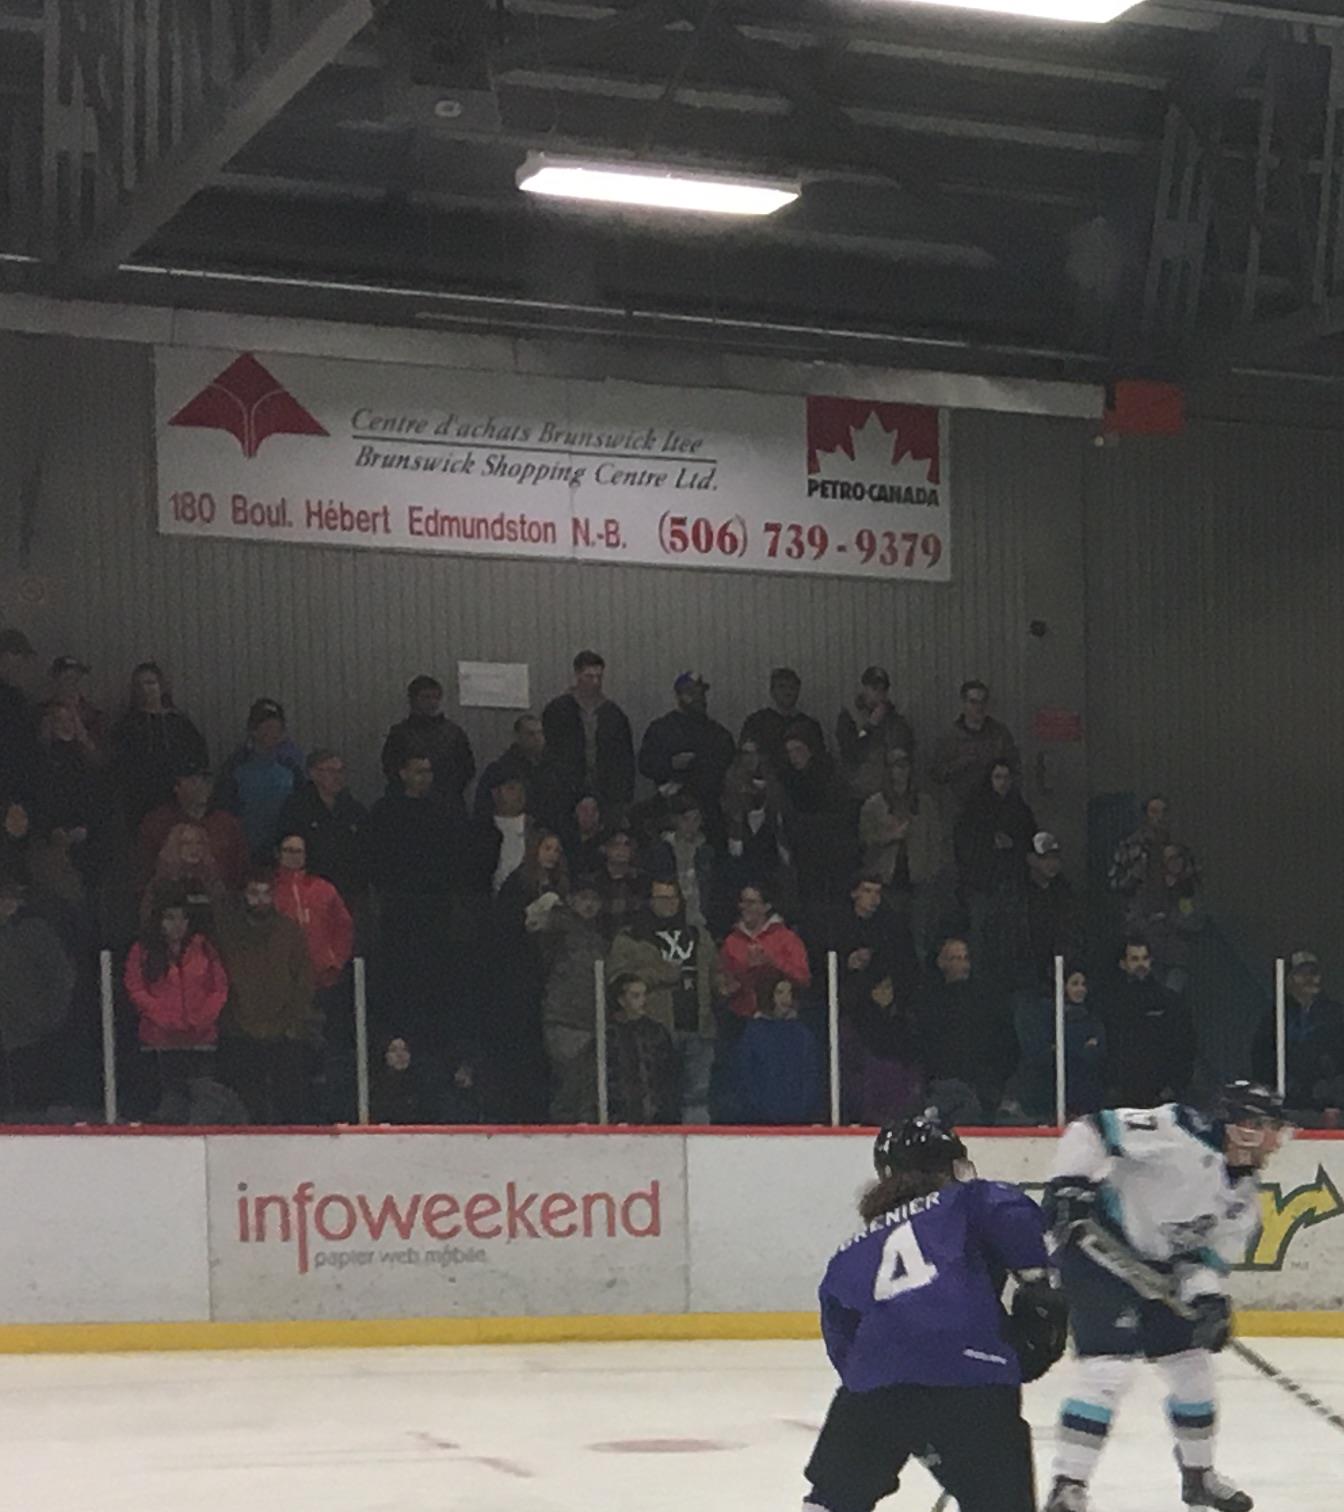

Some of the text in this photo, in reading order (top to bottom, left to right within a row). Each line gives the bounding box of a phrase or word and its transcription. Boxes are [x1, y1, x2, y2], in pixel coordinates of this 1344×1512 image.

[351, 407, 427, 435] Centre
[434, 415, 530, 443] d'achats
[538, 422, 657, 452] Brunswick
[355, 445, 719, 492] Brunswick Shopping Centre Ltd.
[168, 493, 216, 525] 180
[231, 493, 294, 529] Boul.
[306, 499, 392, 536] Hébert
[408, 506, 557, 545] Edmundston
[658, 509, 748, 559] (506)
[763, 521, 829, 561] 739
[855, 528, 943, 569] 9379
[237, 1180, 662, 1274] infoweekend
[314, 1245, 488, 1269] papier web mobile
[873, 1219, 940, 1302] 4
